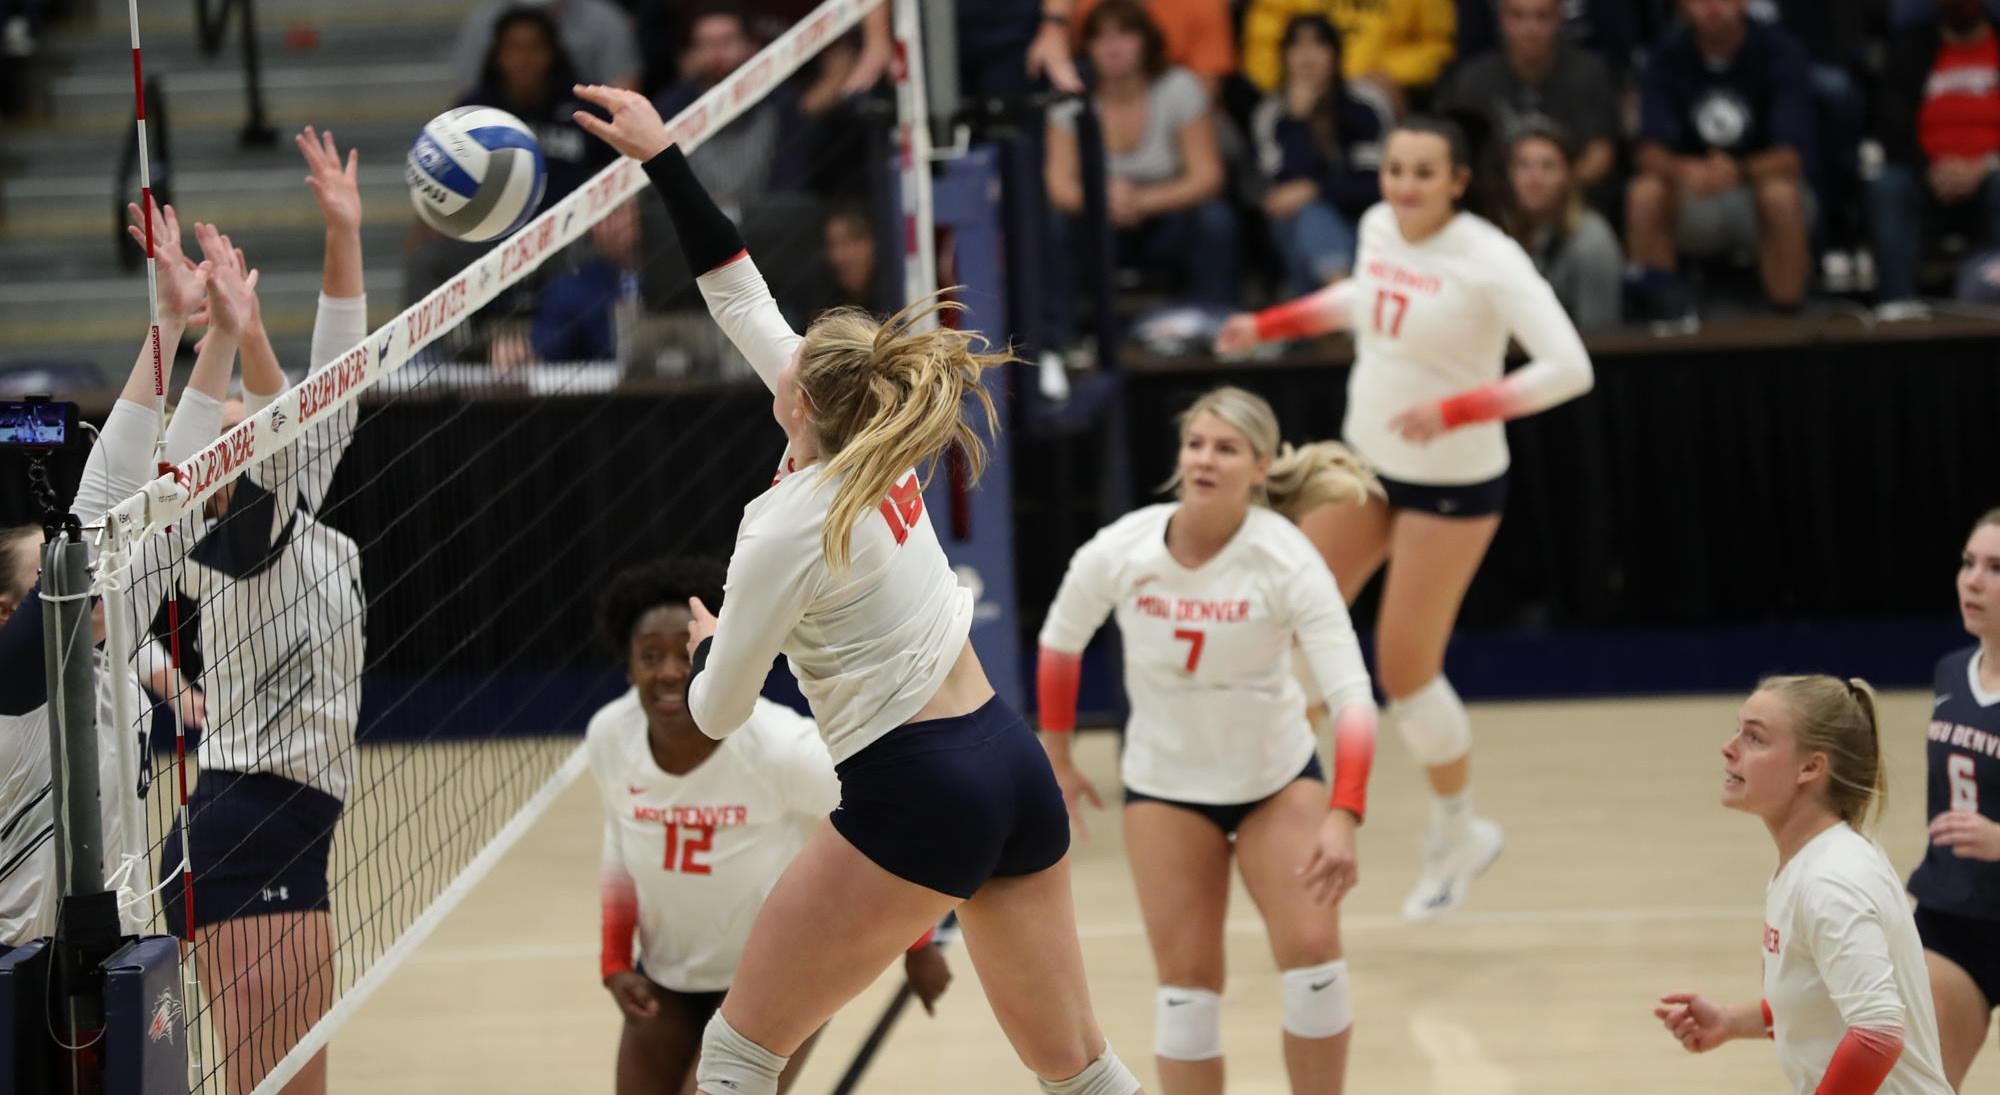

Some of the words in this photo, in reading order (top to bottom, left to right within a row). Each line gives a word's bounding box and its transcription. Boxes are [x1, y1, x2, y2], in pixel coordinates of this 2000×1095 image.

[1372, 289, 1409, 339] 17
[1136, 595, 1170, 619] MSU
[1177, 598, 1249, 623] DENVER
[1173, 629, 1206, 673] 7
[1951, 723, 2000, 760] DENV
[1947, 752, 1979, 815] 6
[672, 805, 747, 826] DENVER
[662, 821, 715, 875] 12
